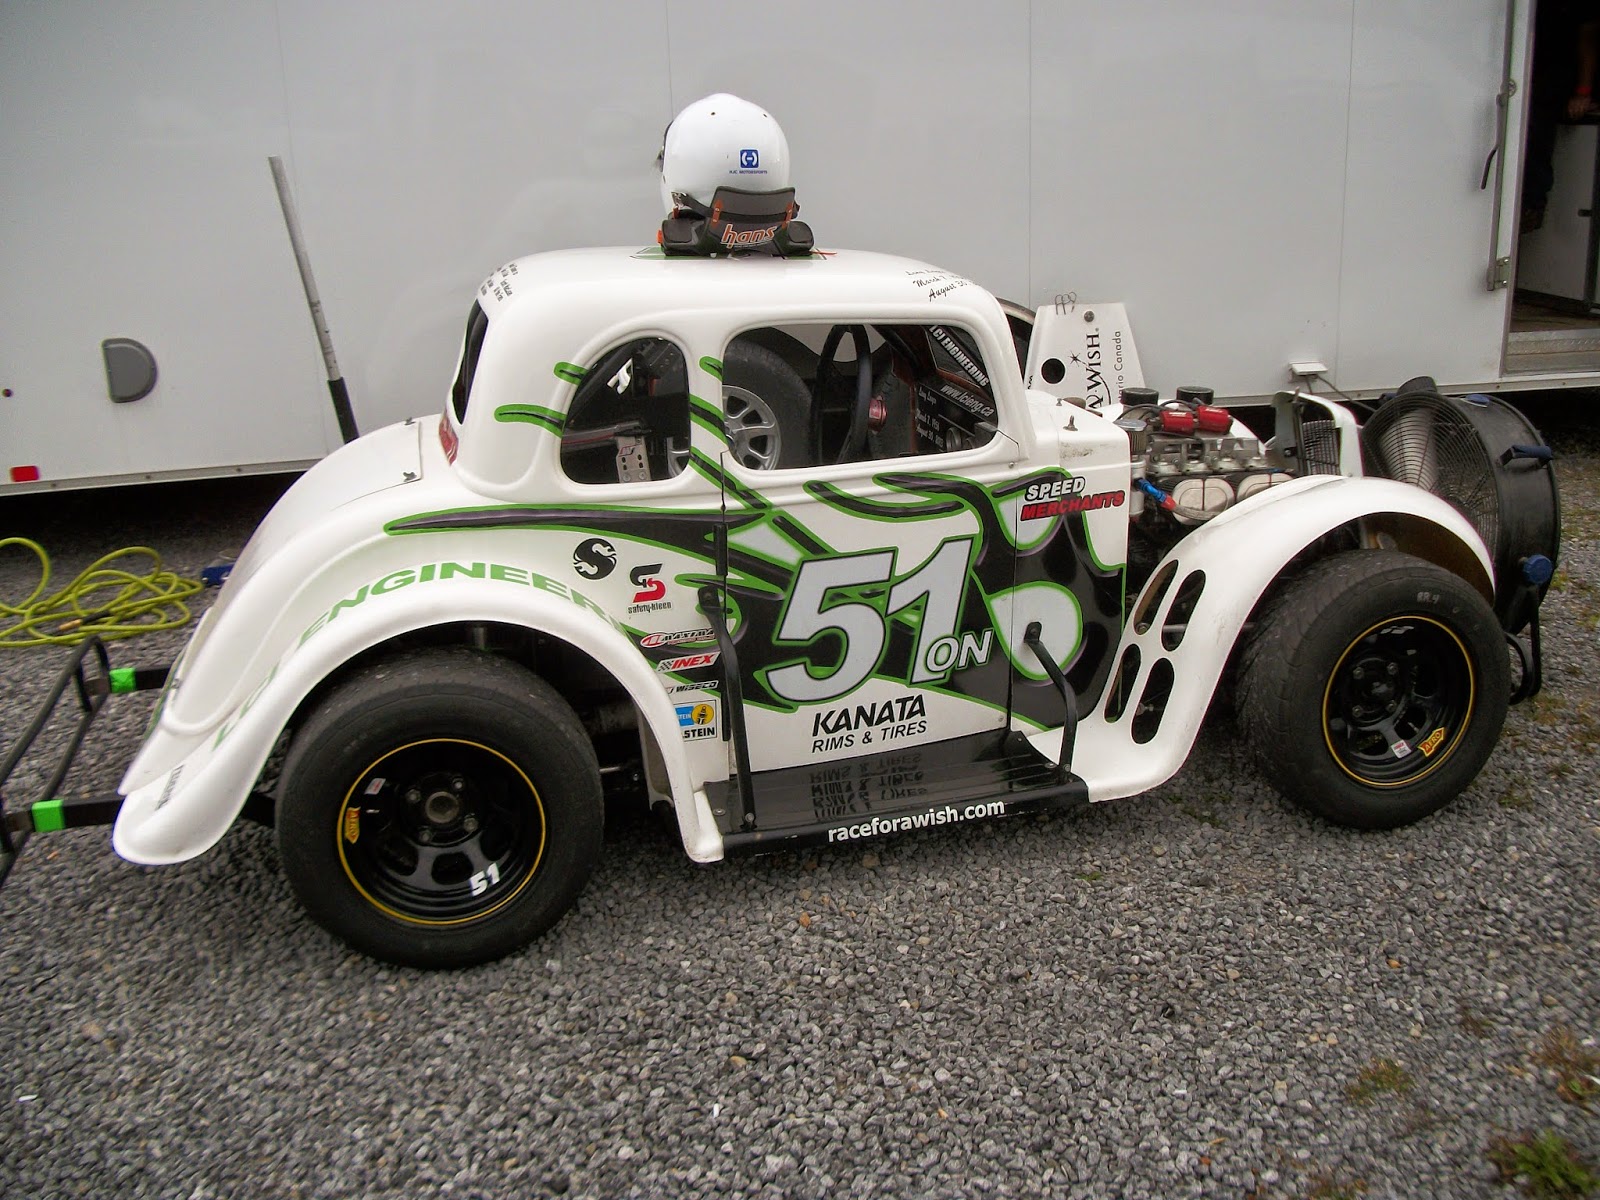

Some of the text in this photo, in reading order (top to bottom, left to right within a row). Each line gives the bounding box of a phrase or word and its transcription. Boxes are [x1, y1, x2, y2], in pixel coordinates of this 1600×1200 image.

[721, 223, 778, 249] hans
[929, 284, 957, 303] August
[941, 336, 990, 387] ENGINEERING
[1111, 330, 1123, 371] Canada
[1025, 476, 1085, 501] SPEED
[1020, 490, 1125, 521] MERCHANTS
[628, 601, 673, 615] safety-kleen
[765, 536, 975, 703] 51
[671, 654, 716, 670] INEX
[926, 628, 994, 674] ON
[676, 681, 717, 693] WISECO
[812, 694, 926, 737] KANATA
[683, 727, 715, 739] STEIN
[812, 720, 928, 753] RIMS & TIRES
[828, 800, 1005, 843] raceforawish.com
[470, 862, 501, 897] 51
